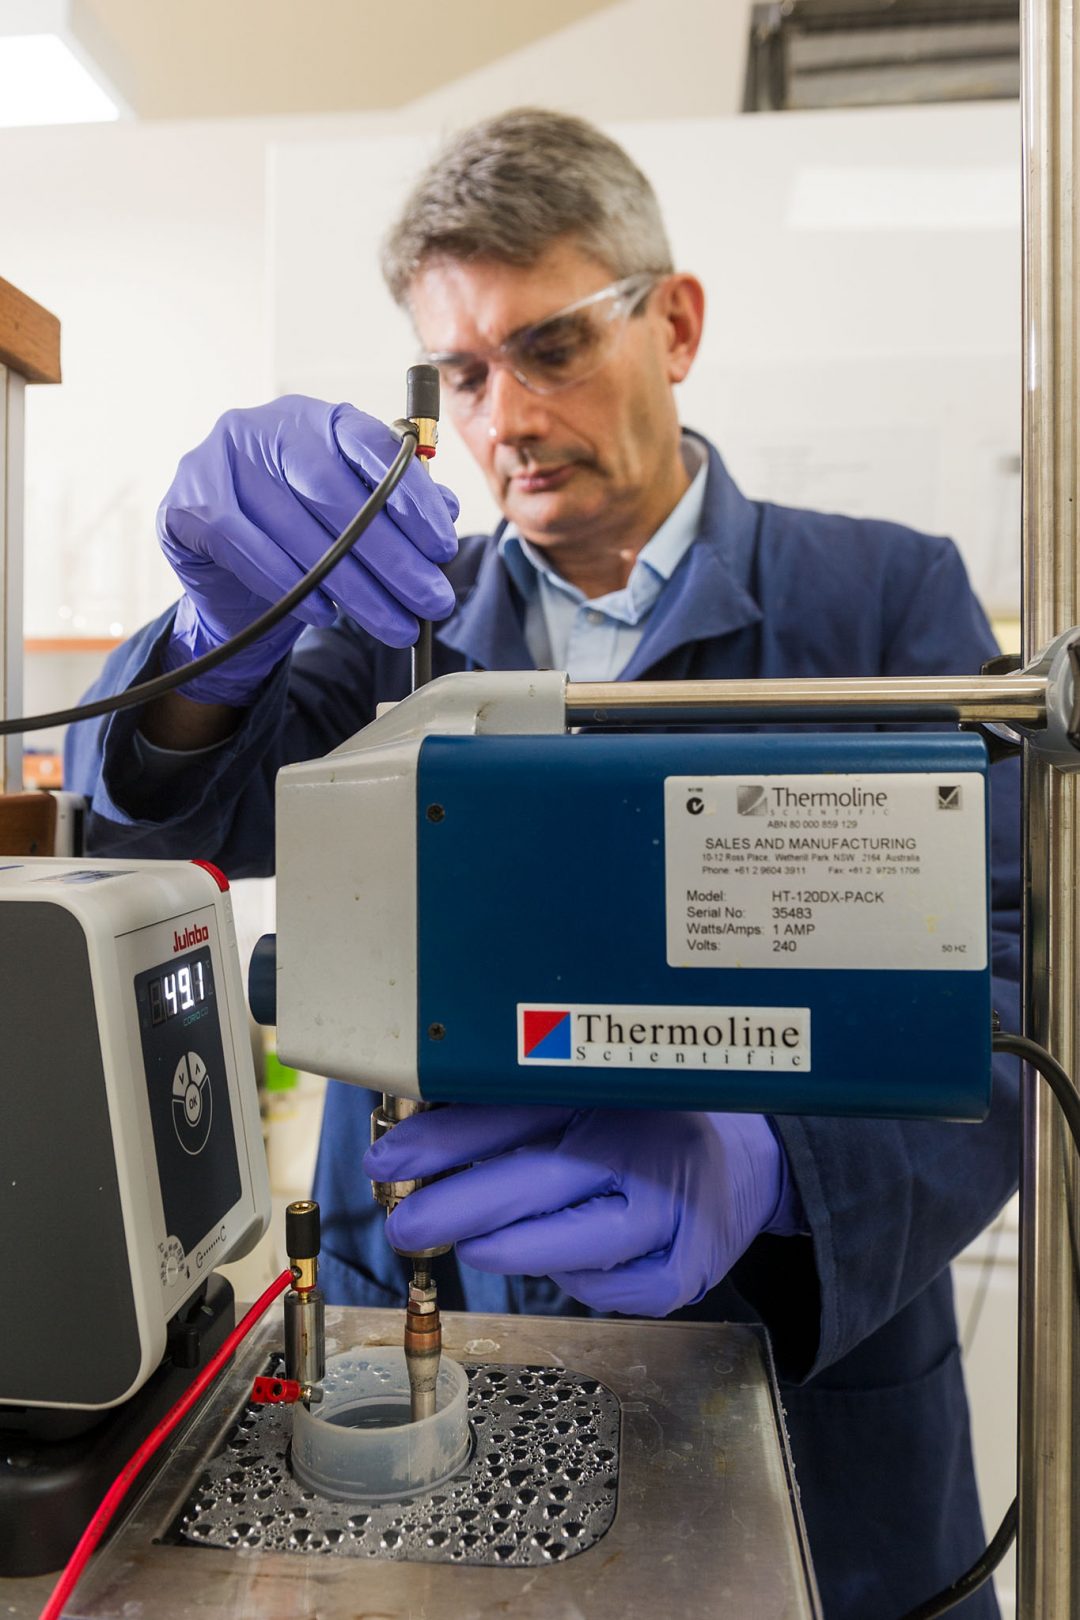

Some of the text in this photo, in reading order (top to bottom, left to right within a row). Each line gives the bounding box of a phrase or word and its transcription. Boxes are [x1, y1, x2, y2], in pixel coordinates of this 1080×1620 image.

[772, 787, 887, 807] Thermoline
[706, 838, 916, 849] SALES AND MANUFACTURING
[702, 853, 724, 861] 10-12
[725, 853, 744, 861] Ross
[775, 853, 808, 861] Wetherill
[811, 853, 829, 861] Park
[834, 853, 854, 861] NSW
[886, 854, 920, 862] Australia
[735, 866, 750, 874] +61
[752, 866, 757, 874] 2
[687, 891, 726, 902] Model:
[772, 892, 884, 903] HT-120DX-PACK
[687, 907, 745, 918] Serial No:
[772, 908, 812, 919] 35483
[687, 923, 764, 936] Watts/Amps:
[773, 924, 815, 935] 1 AMP
[173, 924, 209, 952] Julabo
[687, 940, 720, 951] Volts:
[773, 941, 797, 952] 240
[577, 1014, 800, 1047] Thermoline
[576, 1047, 801, 1066] Scientific
[189, 1095, 198, 1110] OK
